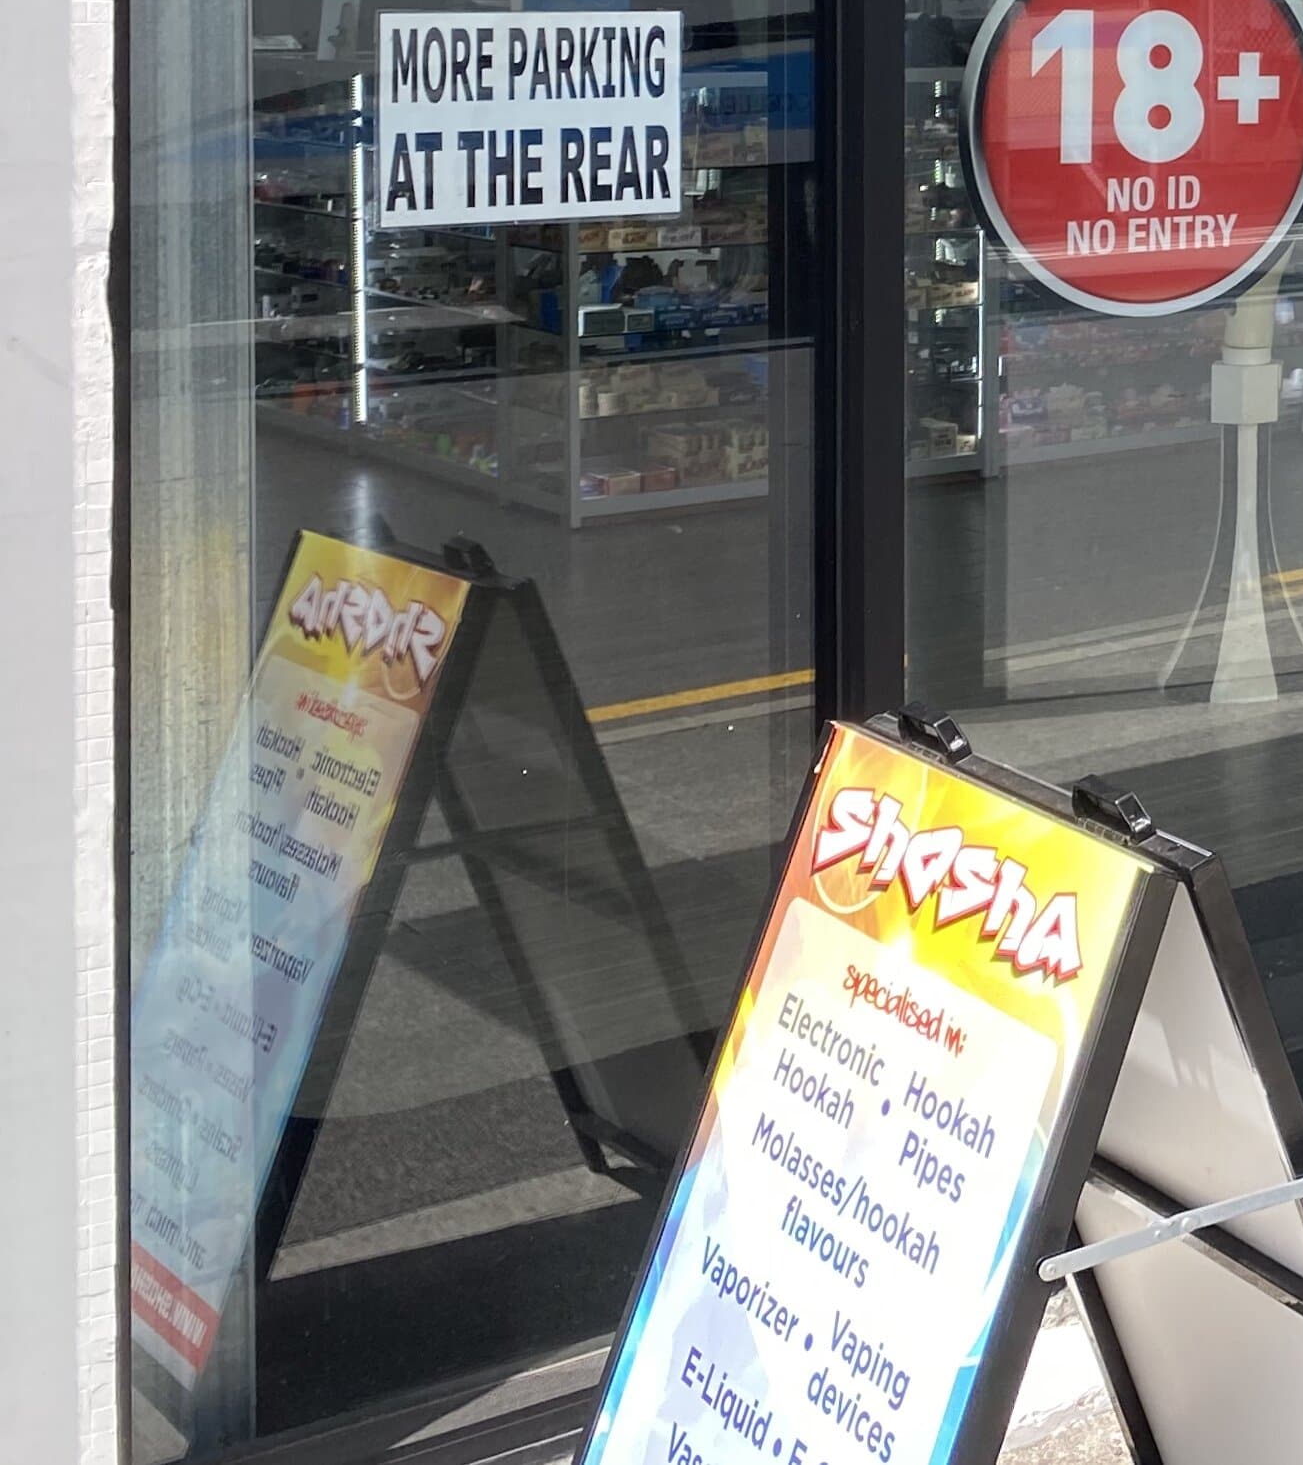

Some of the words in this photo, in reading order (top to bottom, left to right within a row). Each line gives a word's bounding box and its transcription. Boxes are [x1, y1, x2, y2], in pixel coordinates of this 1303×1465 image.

[391, 26, 494, 104] MORE
[507, 24, 666, 101] PARKING
[1031, 9, 1280, 165] 18+
[385, 131, 443, 212] AT
[457, 128, 544, 209] THE
[559, 124, 672, 205] REAR
[1106, 177, 1156, 213] NO
[1167, 174, 1201, 211] ID
[1066, 220, 1116, 256] NO
[1127, 213, 1238, 253] ENTRY
[776, 991, 888, 1087] Electronic
[843, 964, 945, 1044] specialised
[943, 1015, 968, 1059] in:
[773, 1051, 855, 1131] Hookah
[902, 1070, 997, 1160] Hookah
[752, 1112, 942, 1277] Molasses/hookah
[899, 1129, 966, 1204] Pipes
[780, 1195, 871, 1290] flavours
[701, 1236, 800, 1348] Vaporizer
[680, 1345, 773, 1451] E-Liquid
[829, 1311, 912, 1411] Vaping
[806, 1365, 897, 1464] devices
